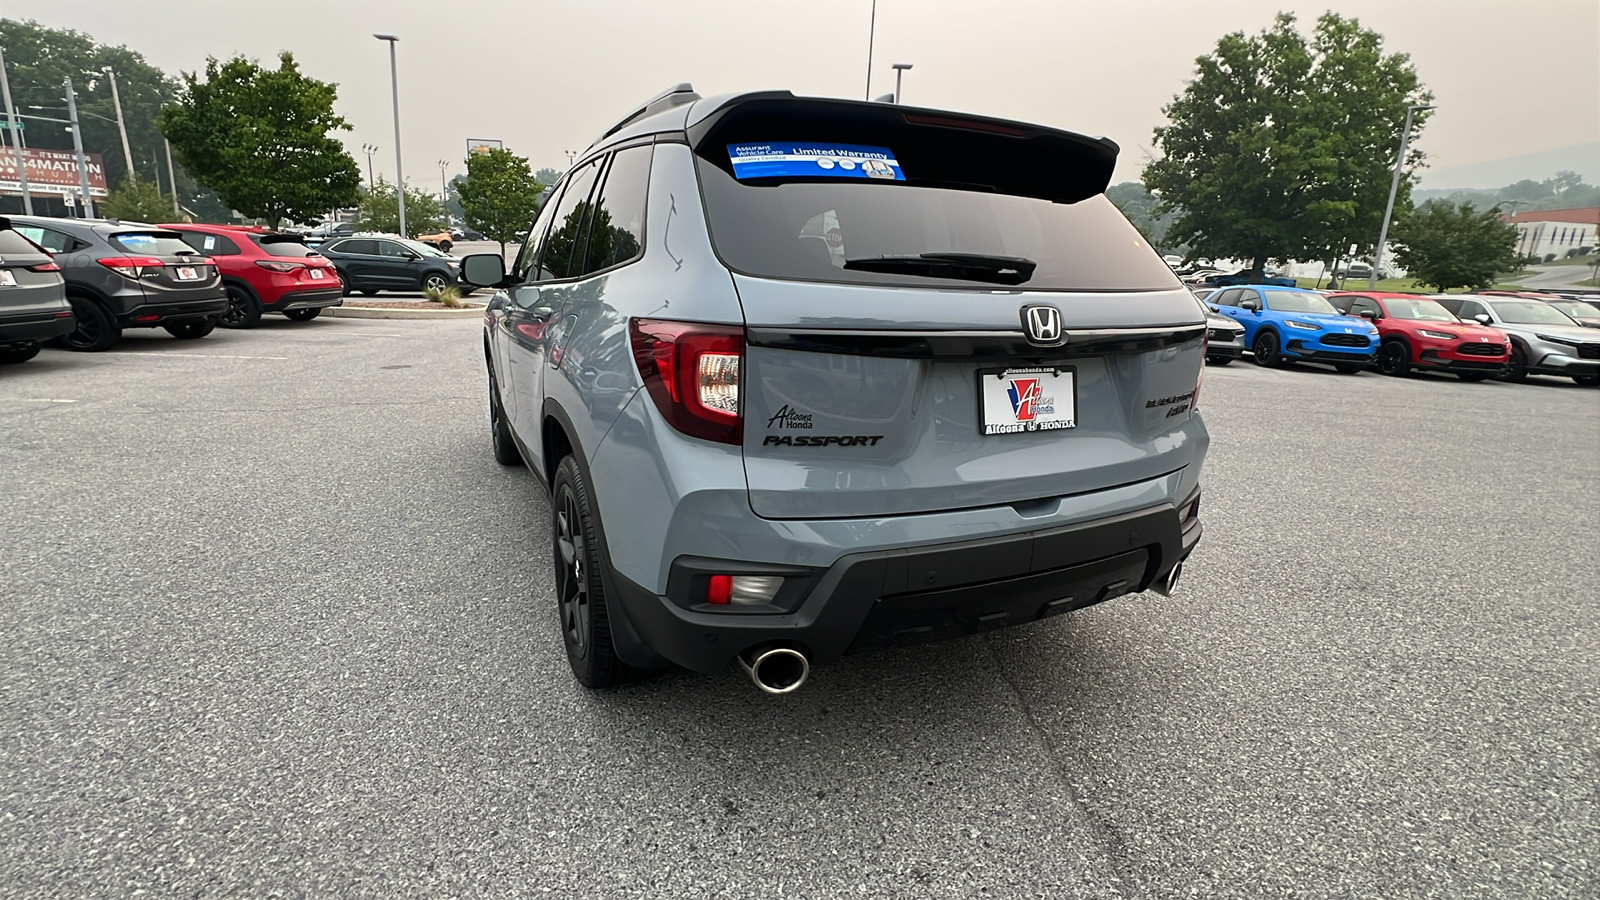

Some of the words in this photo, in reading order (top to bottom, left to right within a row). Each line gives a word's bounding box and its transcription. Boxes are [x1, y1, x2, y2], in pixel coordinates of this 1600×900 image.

[793, 148, 835, 157] Limited
[836, 149, 888, 160] Warranty
[767, 404, 813, 429] Altoona
[786, 420, 813, 429] Honda
[985, 425, 1025, 435] Altoona
[1040, 419, 1076, 431] HONDA
[762, 435, 884, 447] PASSPORT
